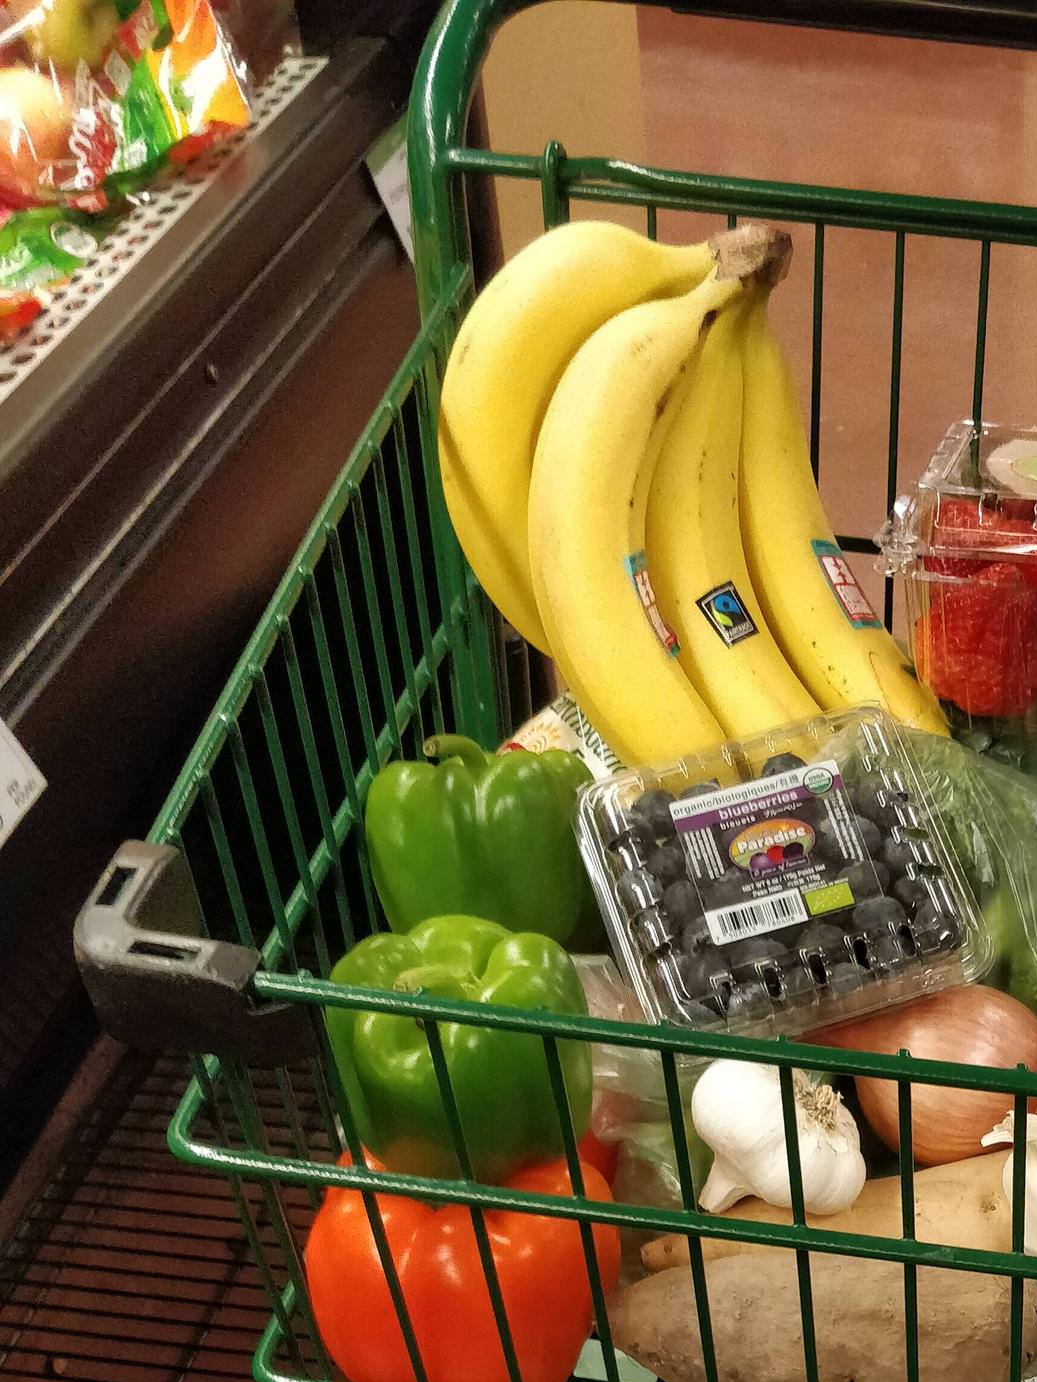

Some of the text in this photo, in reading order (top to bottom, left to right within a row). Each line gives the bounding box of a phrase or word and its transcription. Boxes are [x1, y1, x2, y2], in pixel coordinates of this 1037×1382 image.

[718, 790, 799, 820] blueberries
[720, 816, 756, 830] bleuets
[736, 826, 807, 854] Paradise
